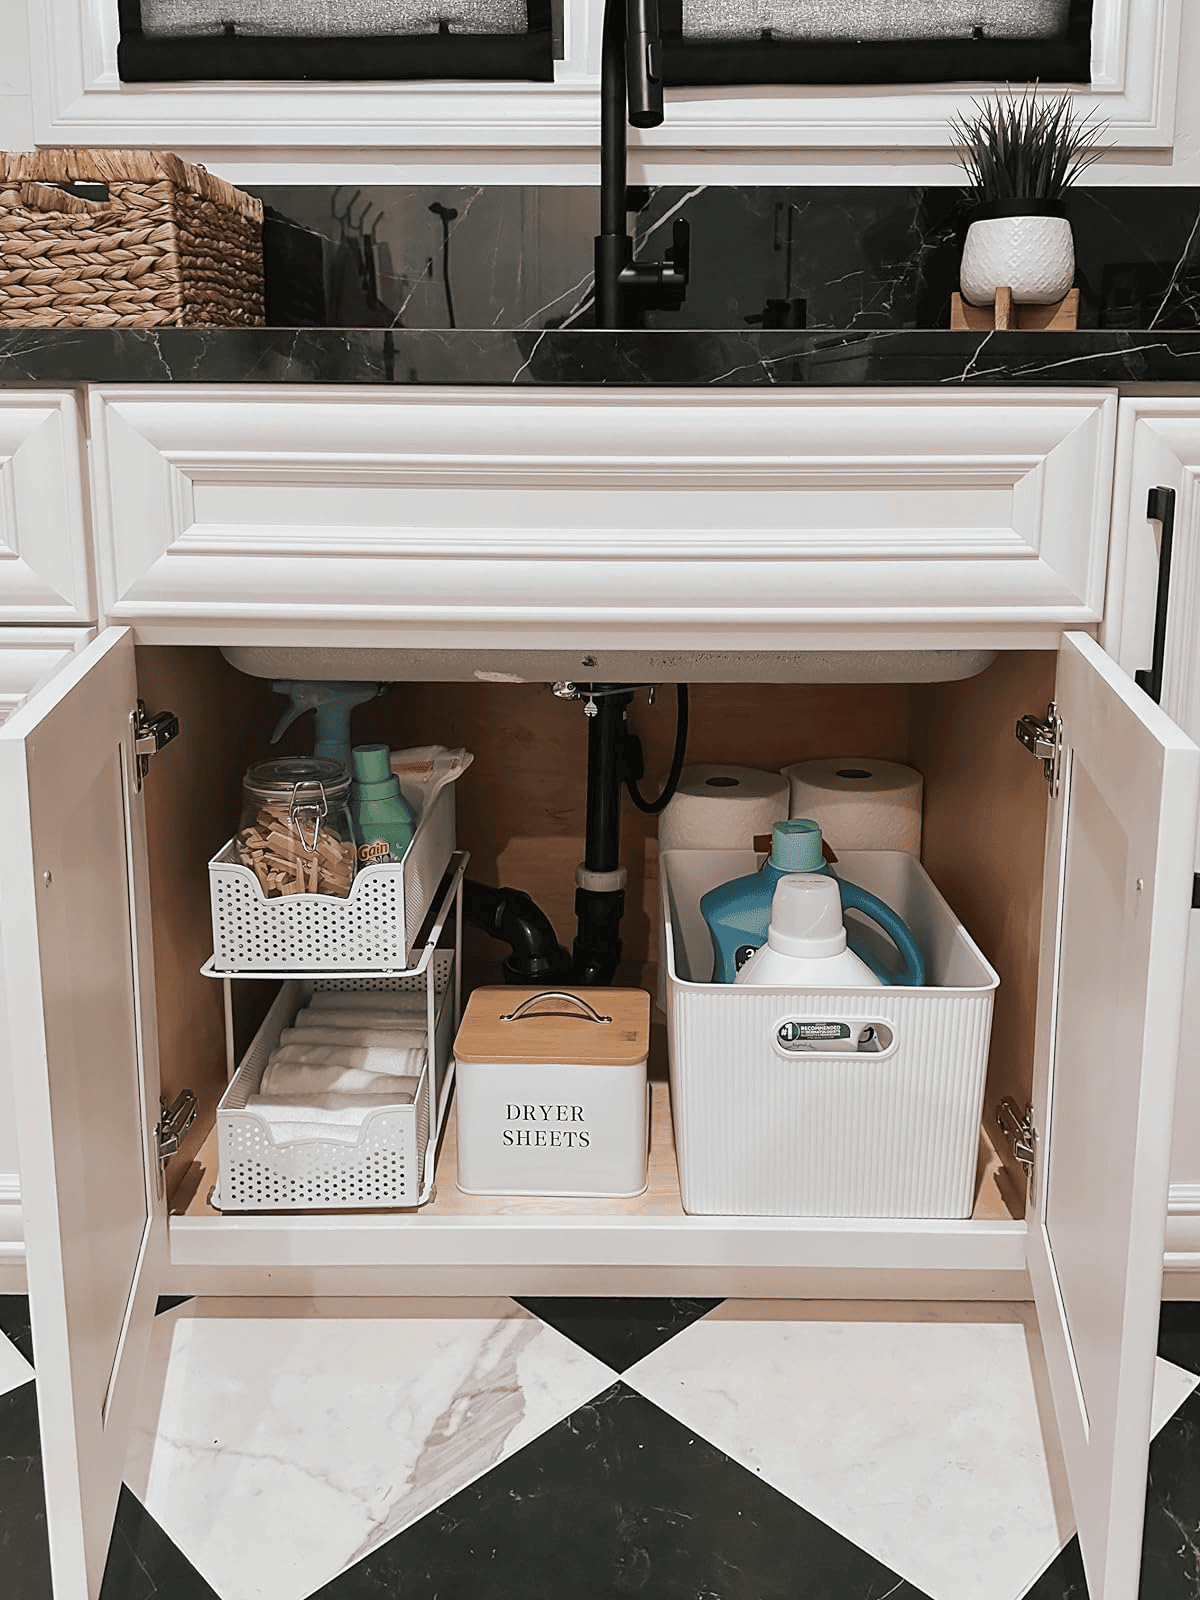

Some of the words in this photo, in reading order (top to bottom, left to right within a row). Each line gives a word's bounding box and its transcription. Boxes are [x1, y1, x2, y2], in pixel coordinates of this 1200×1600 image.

[358, 843, 390, 862] Gain
[780, 1023, 793, 1040] #1
[506, 1104, 585, 1122] DRYER
[502, 1129, 590, 1148] SHEETS
